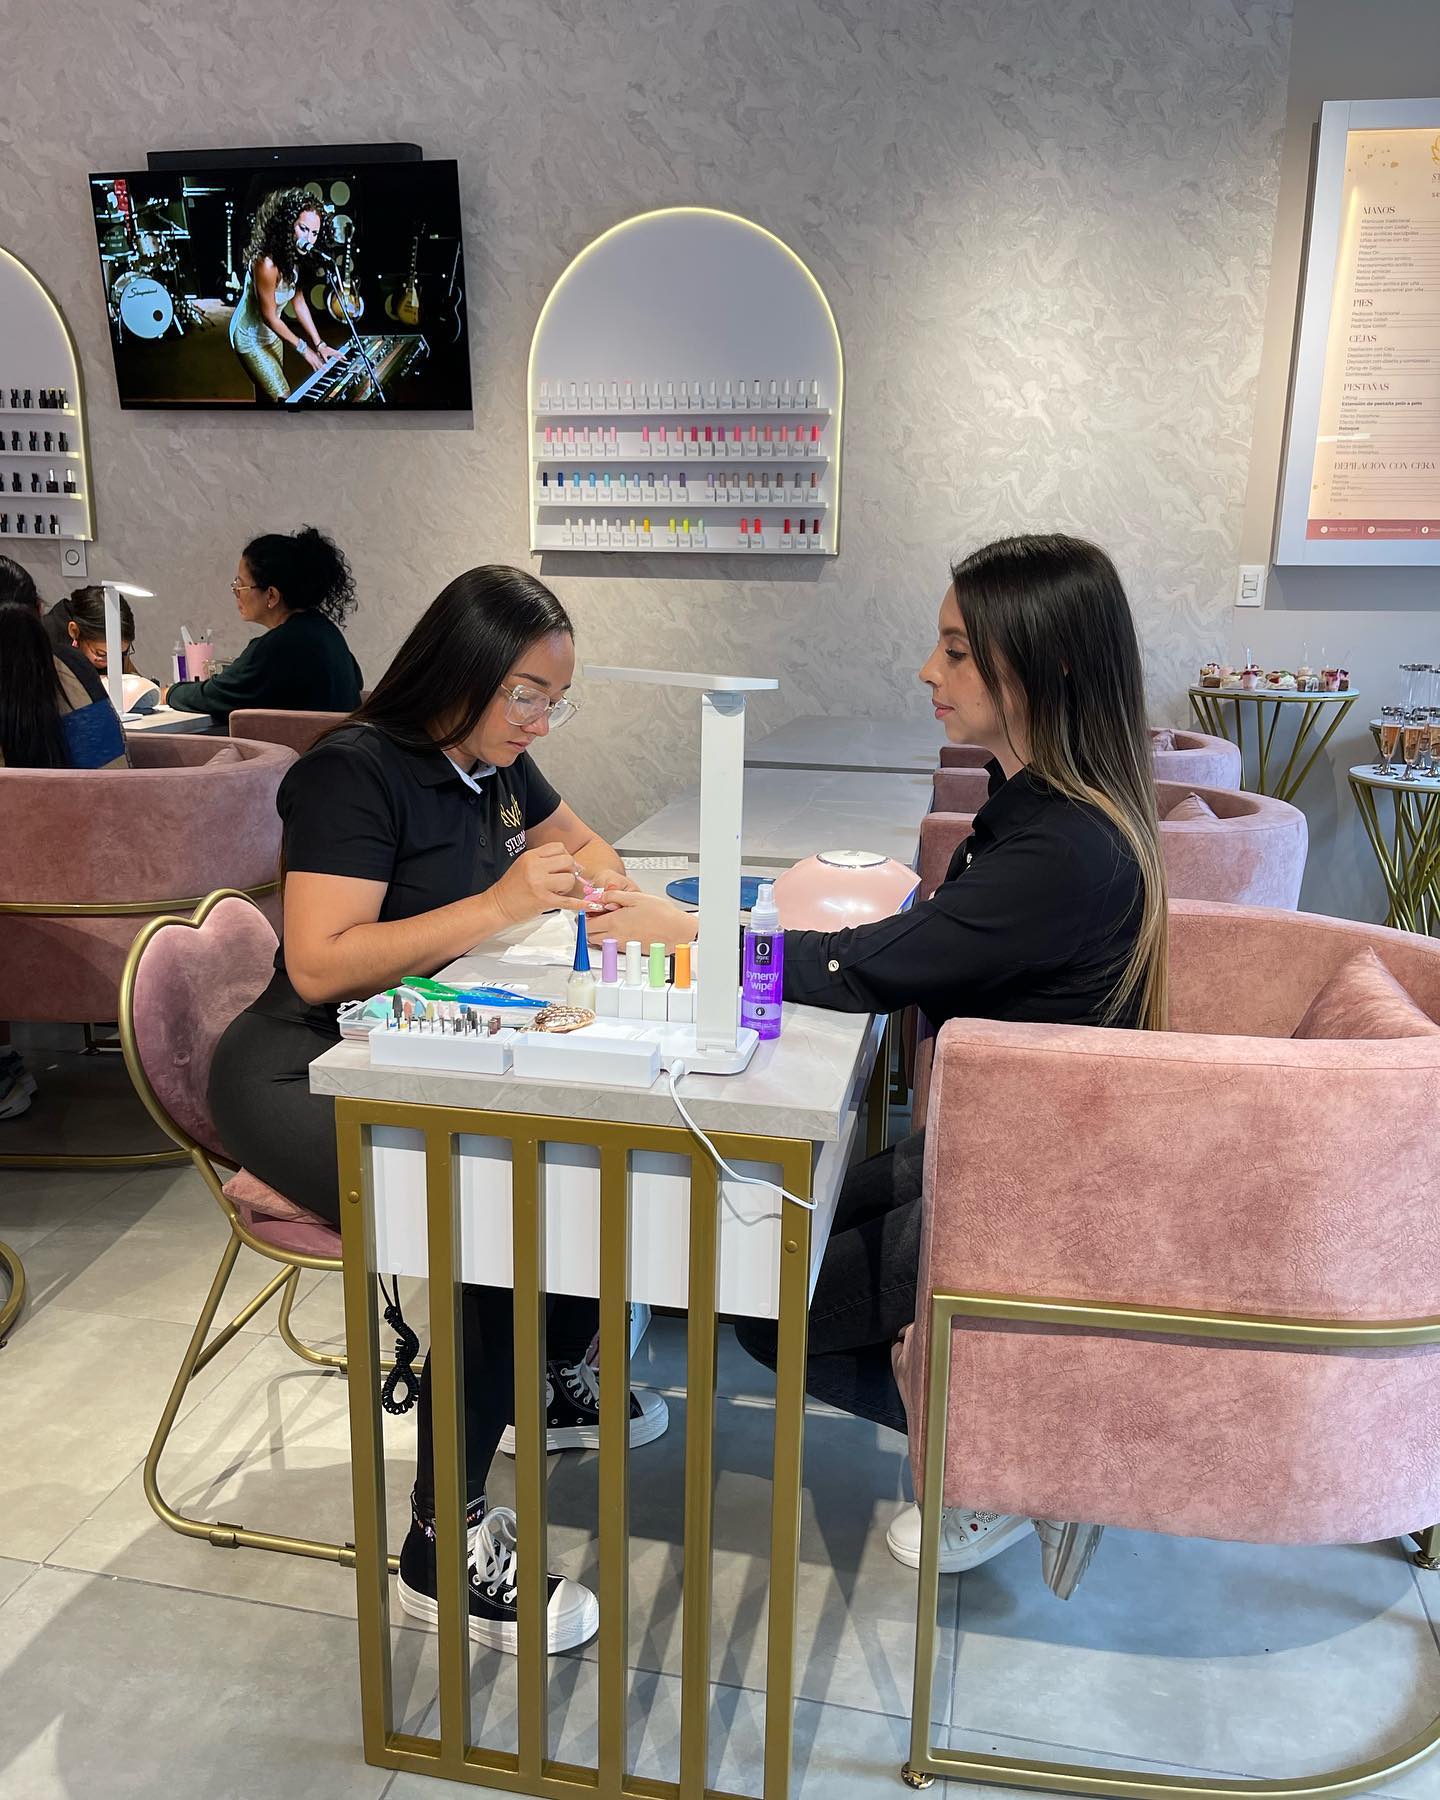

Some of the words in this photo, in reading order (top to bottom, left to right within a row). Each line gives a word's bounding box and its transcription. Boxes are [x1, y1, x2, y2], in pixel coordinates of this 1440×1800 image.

[1363, 206, 1396, 214] MANOS
[1353, 299, 1373, 307] PIES
[504, 830, 526, 852] STUD
[746, 970, 780, 982] synergy
[752, 980, 773, 992] wipe
